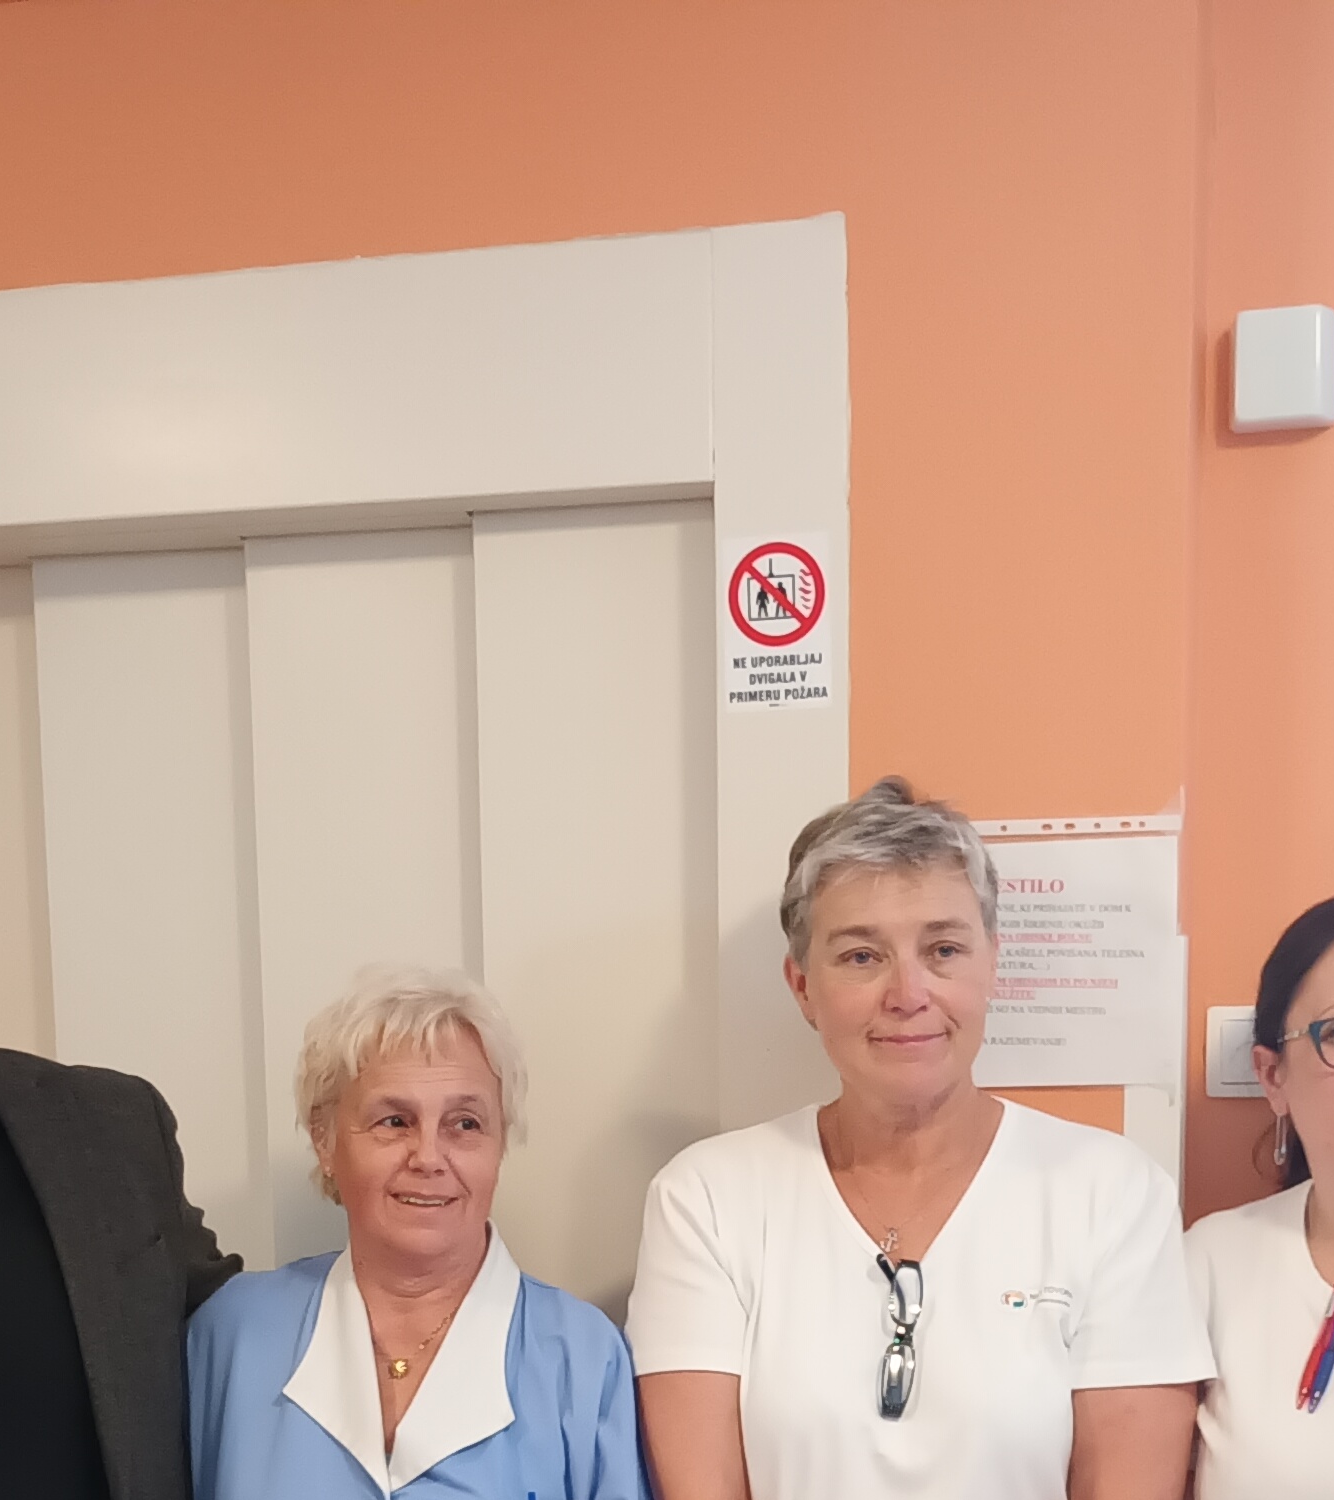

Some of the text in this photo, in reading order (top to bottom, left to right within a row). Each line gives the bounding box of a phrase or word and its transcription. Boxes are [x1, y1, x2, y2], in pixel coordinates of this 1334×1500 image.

[733, 653, 822, 669] NE UPORABLJAJ
[749, 670, 808, 685] DVIGALA V
[729, 686, 828, 703] PRIMERU POŽARA
